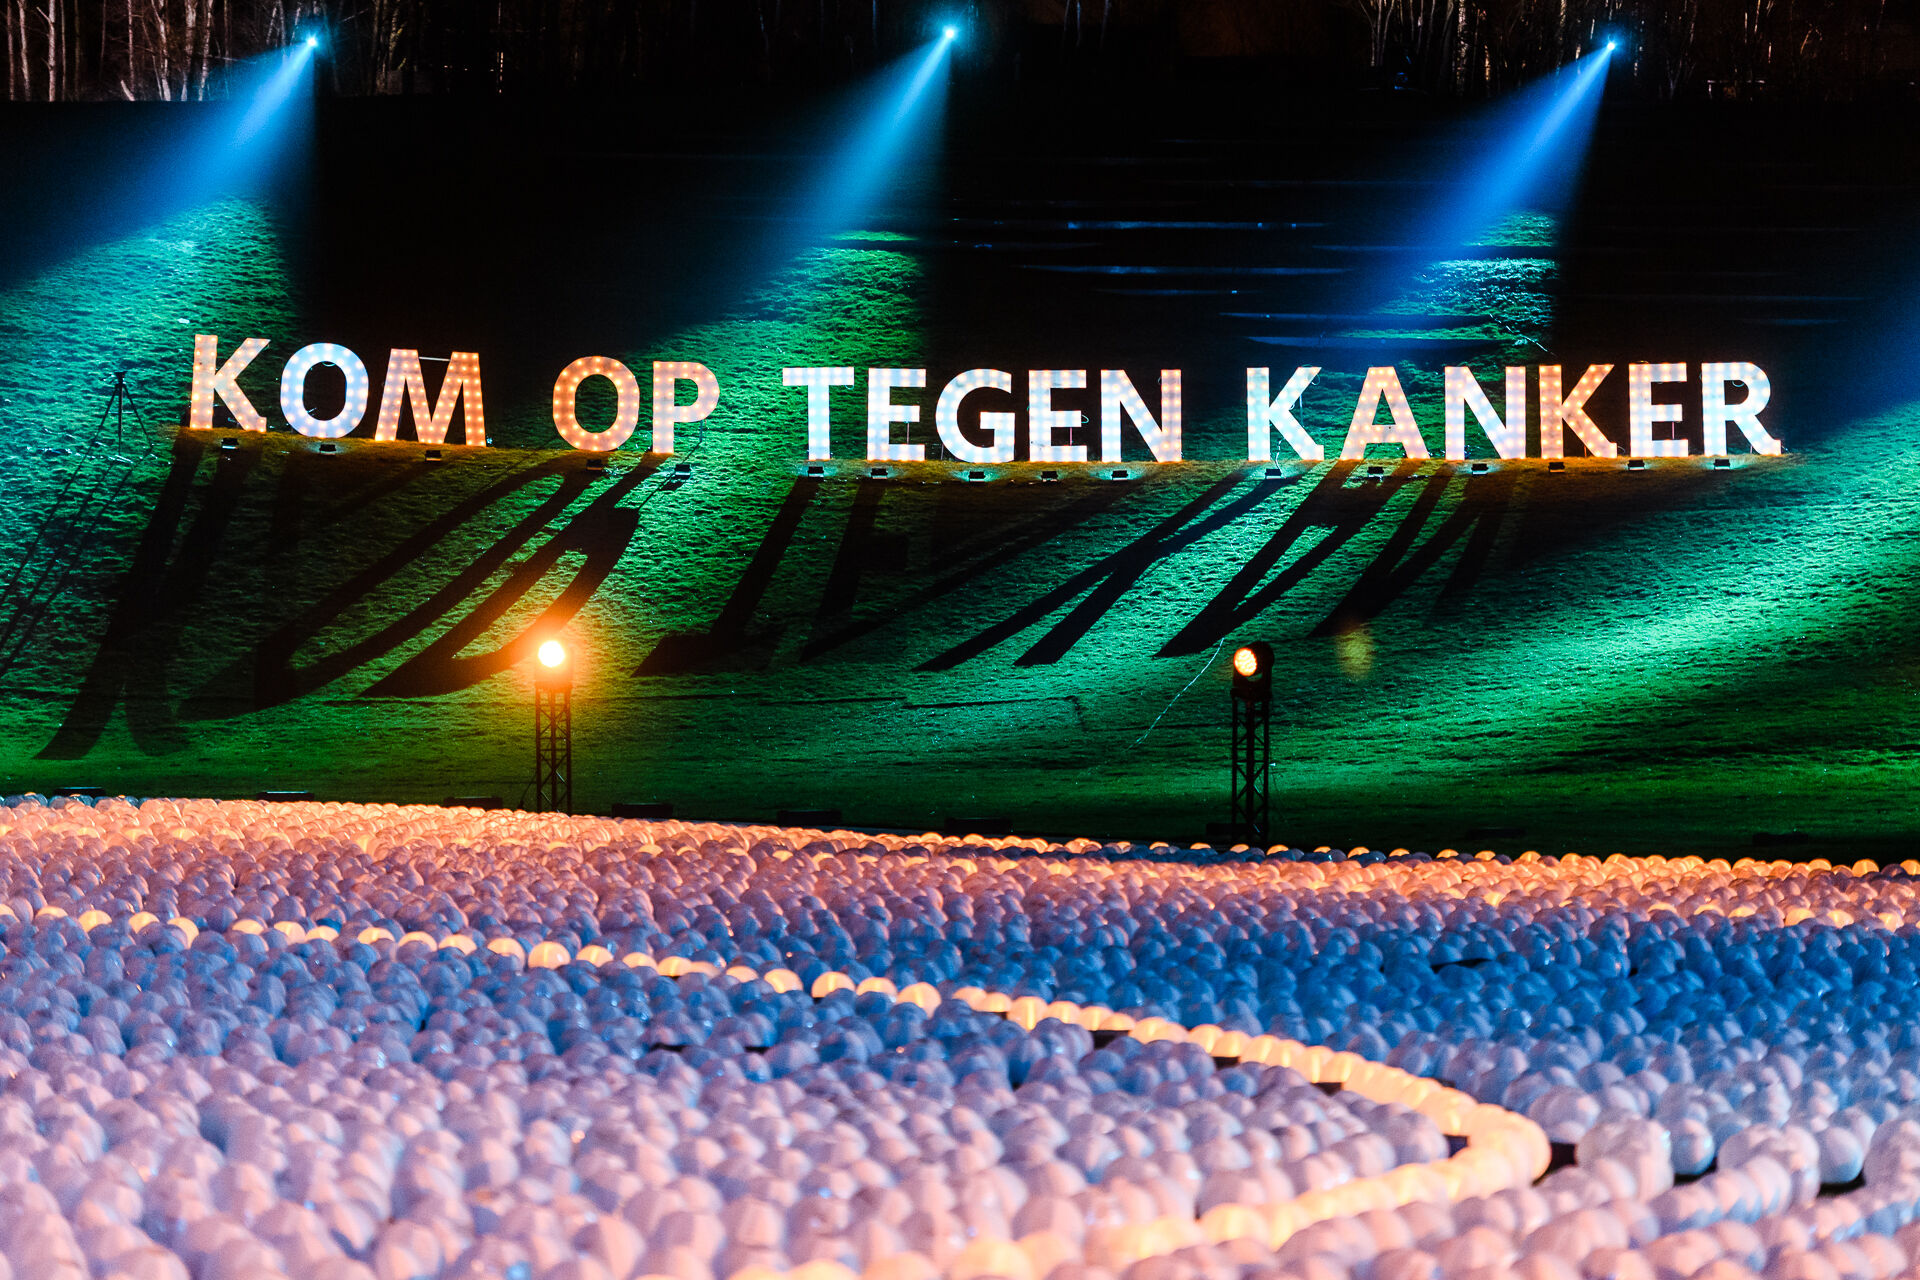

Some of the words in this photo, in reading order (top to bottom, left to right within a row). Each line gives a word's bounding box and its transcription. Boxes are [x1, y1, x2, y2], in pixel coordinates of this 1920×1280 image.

[189, 334, 487, 447] KOM
[552, 355, 720, 455] OP
[782, 366, 1183, 464] TEGEN
[1246, 361, 1782, 462] KANKER
